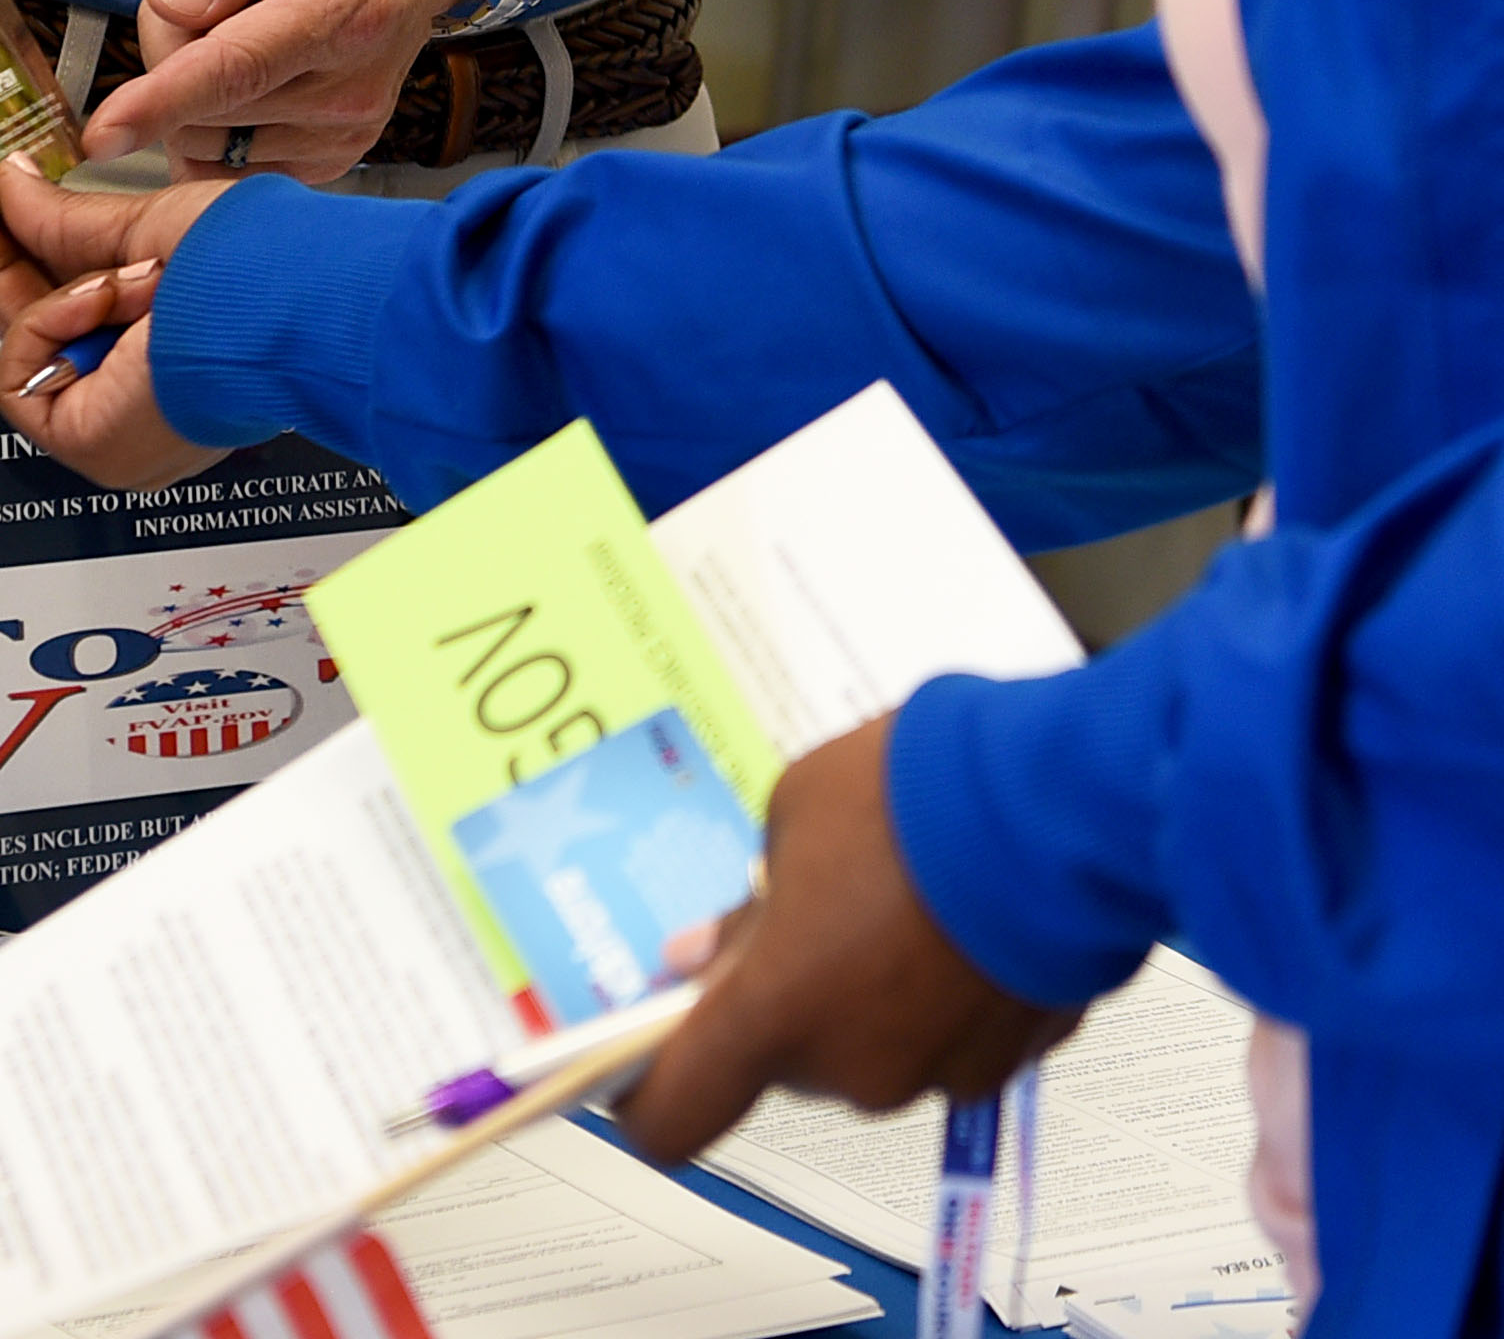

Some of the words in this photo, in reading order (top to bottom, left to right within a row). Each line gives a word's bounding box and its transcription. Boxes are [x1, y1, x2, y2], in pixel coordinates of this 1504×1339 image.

[62, 496, 82, 517] IS
[87, 493, 119, 514] TO
[125, 483, 225, 510] PROVIDE
[229, 470, 348, 500] ACCURATE
[352, 467, 389, 489] AN
[135, 504, 294, 538] INFORMATION
[127, 707, 274, 733] FVAP.gov
[160, 697, 232, 716] Visit
[33, 821, 135, 852] INCLUDE
[140, 814, 186, 839] BUT
[67, 849, 152, 877] FEDER
